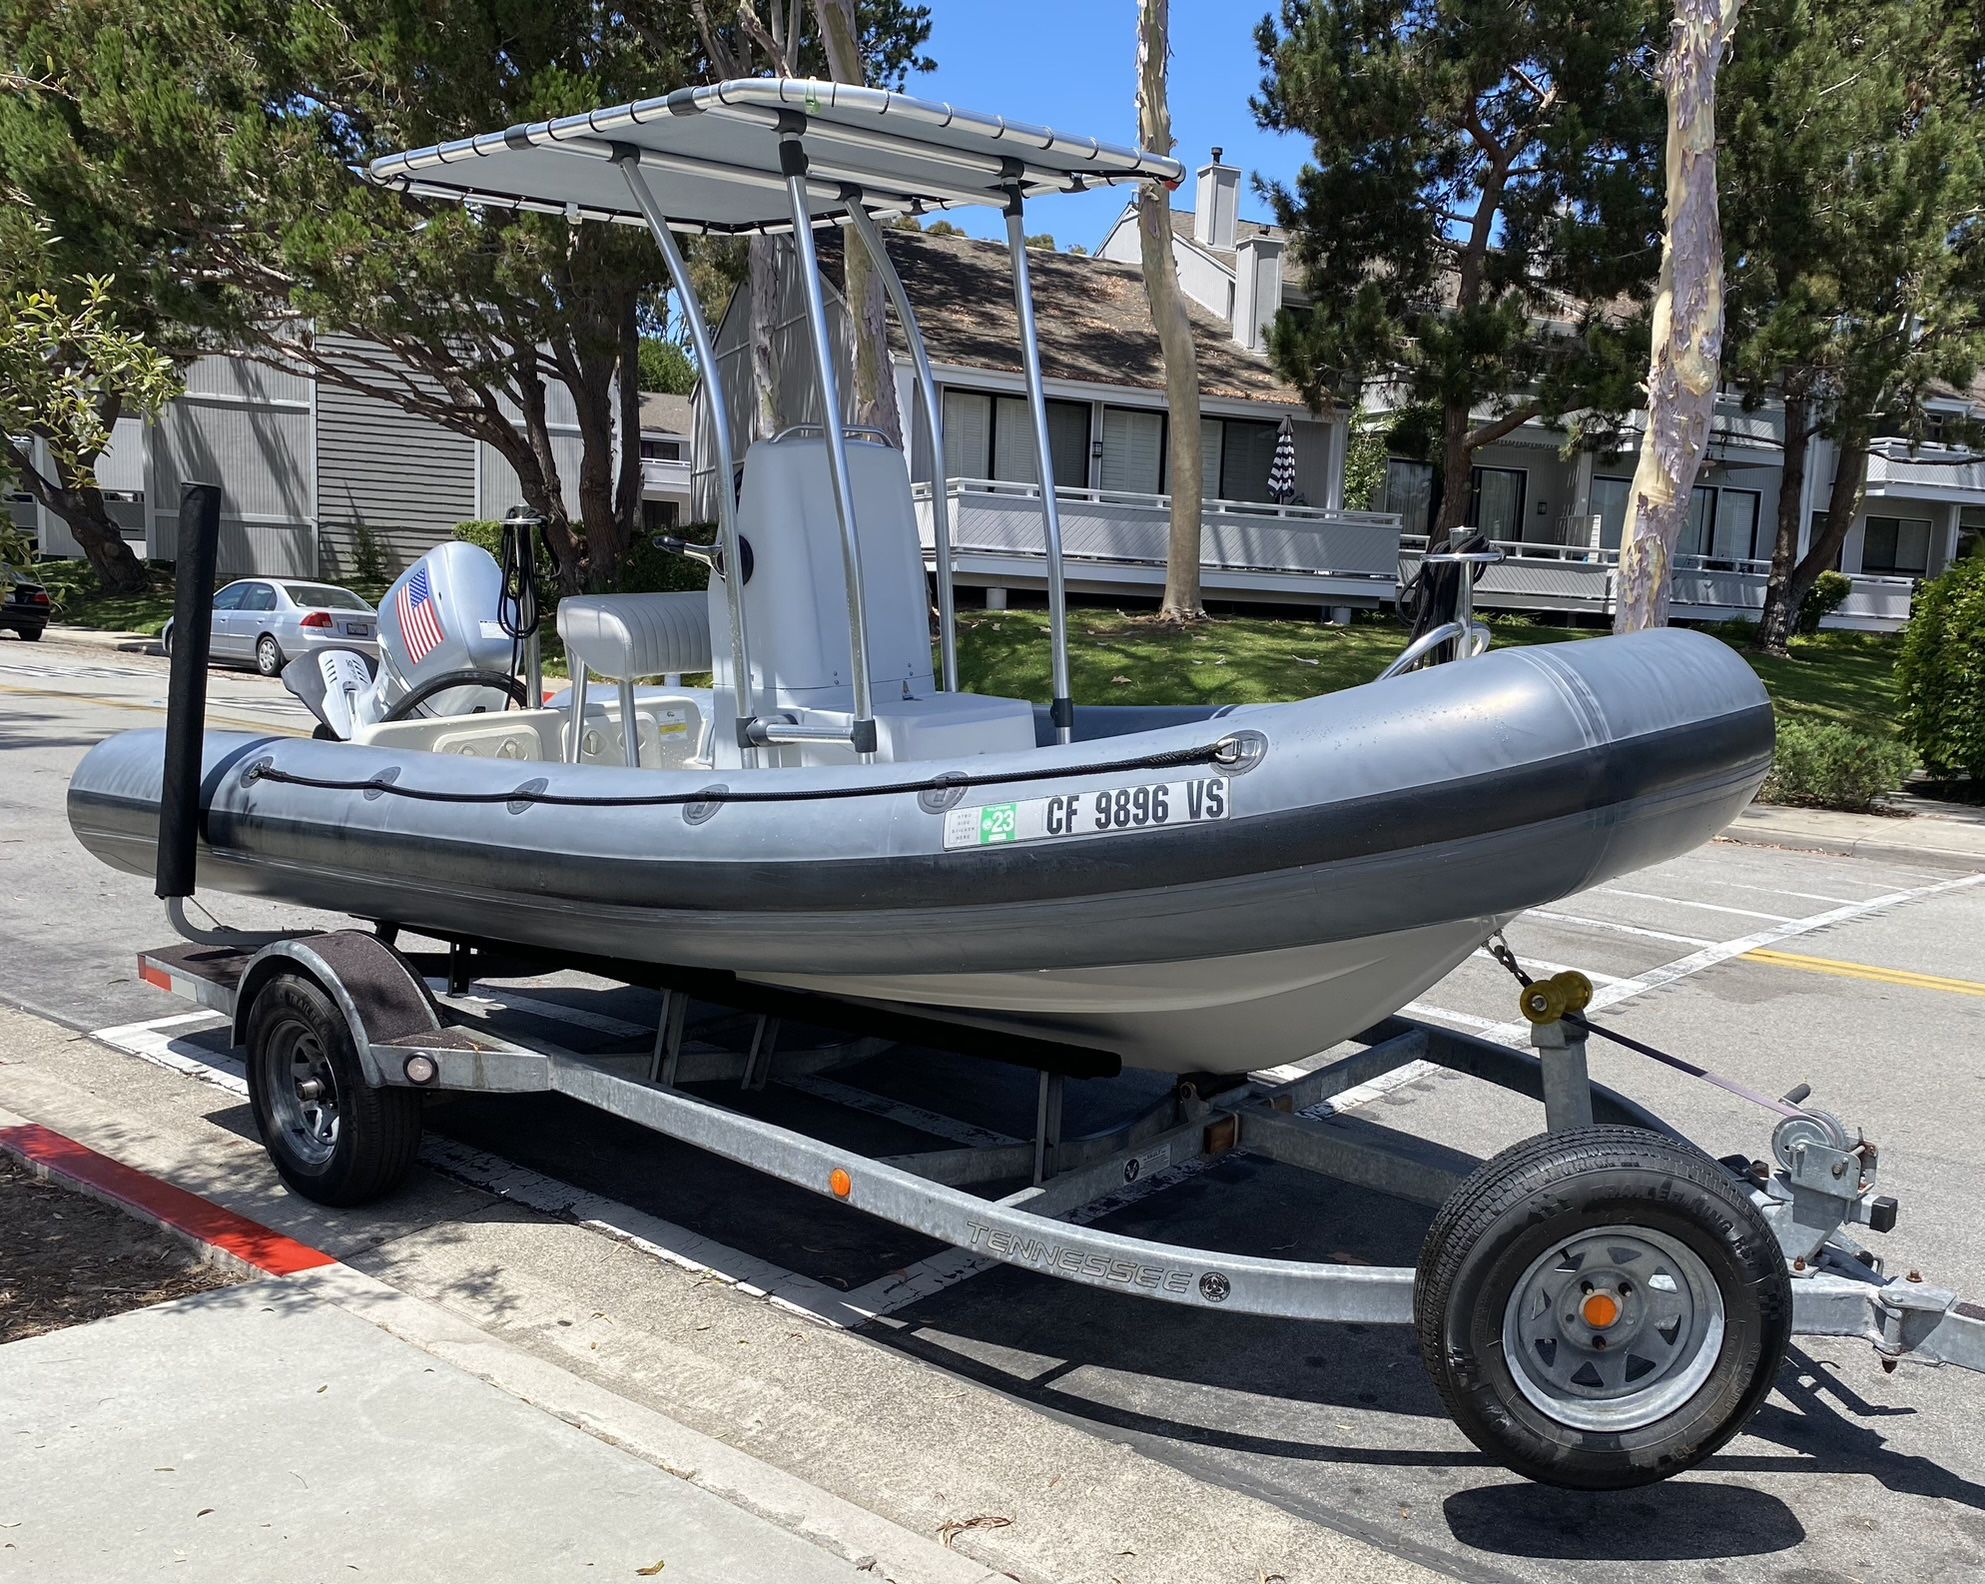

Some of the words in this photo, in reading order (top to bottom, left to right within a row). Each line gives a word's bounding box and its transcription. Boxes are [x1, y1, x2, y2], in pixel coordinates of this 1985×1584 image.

[991, 810, 1015, 833] 23
[1047, 796, 1080, 834] CF
[1095, 784, 1169, 830] 9896
[1186, 778, 1224, 820] VS
[966, 1220, 1193, 1294] TENNESSEE
